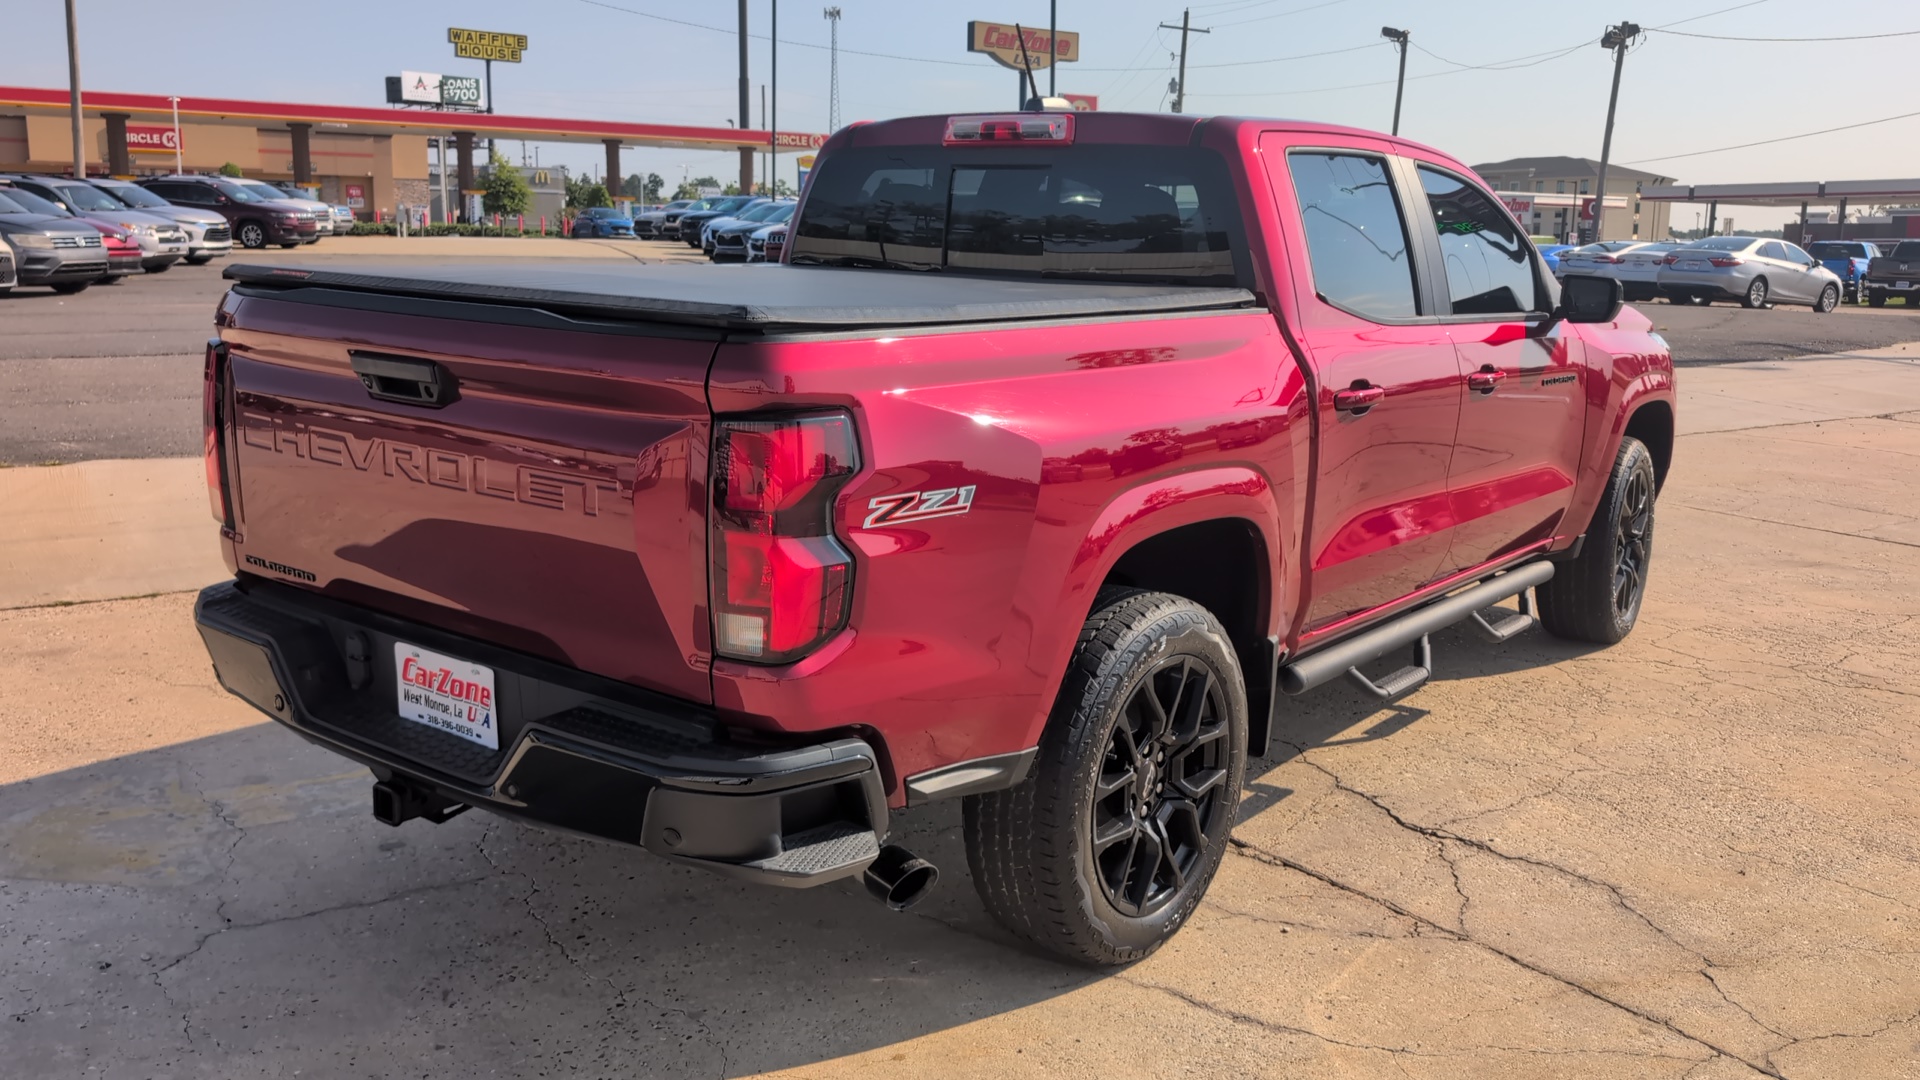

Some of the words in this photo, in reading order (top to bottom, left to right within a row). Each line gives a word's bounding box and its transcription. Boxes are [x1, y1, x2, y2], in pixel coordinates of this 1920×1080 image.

[452, 30, 525, 48] WAFFLE
[984, 26, 1071, 56] CarZone
[460, 45, 519, 60] HOUSE
[450, 88, 478, 101] $700
[126, 132, 160, 144] IRCLE
[243, 412, 621, 517] CHEVROLET
[245, 555, 316, 582] COLORADO
[402, 657, 492, 711] CarZone
[403, 688, 422, 706] West
[424, 694, 453, 718] Monroe,
[454, 704, 463, 718] La
[427, 714, 473, 737] 318-396-0039
[467, 705, 490, 729] UA
